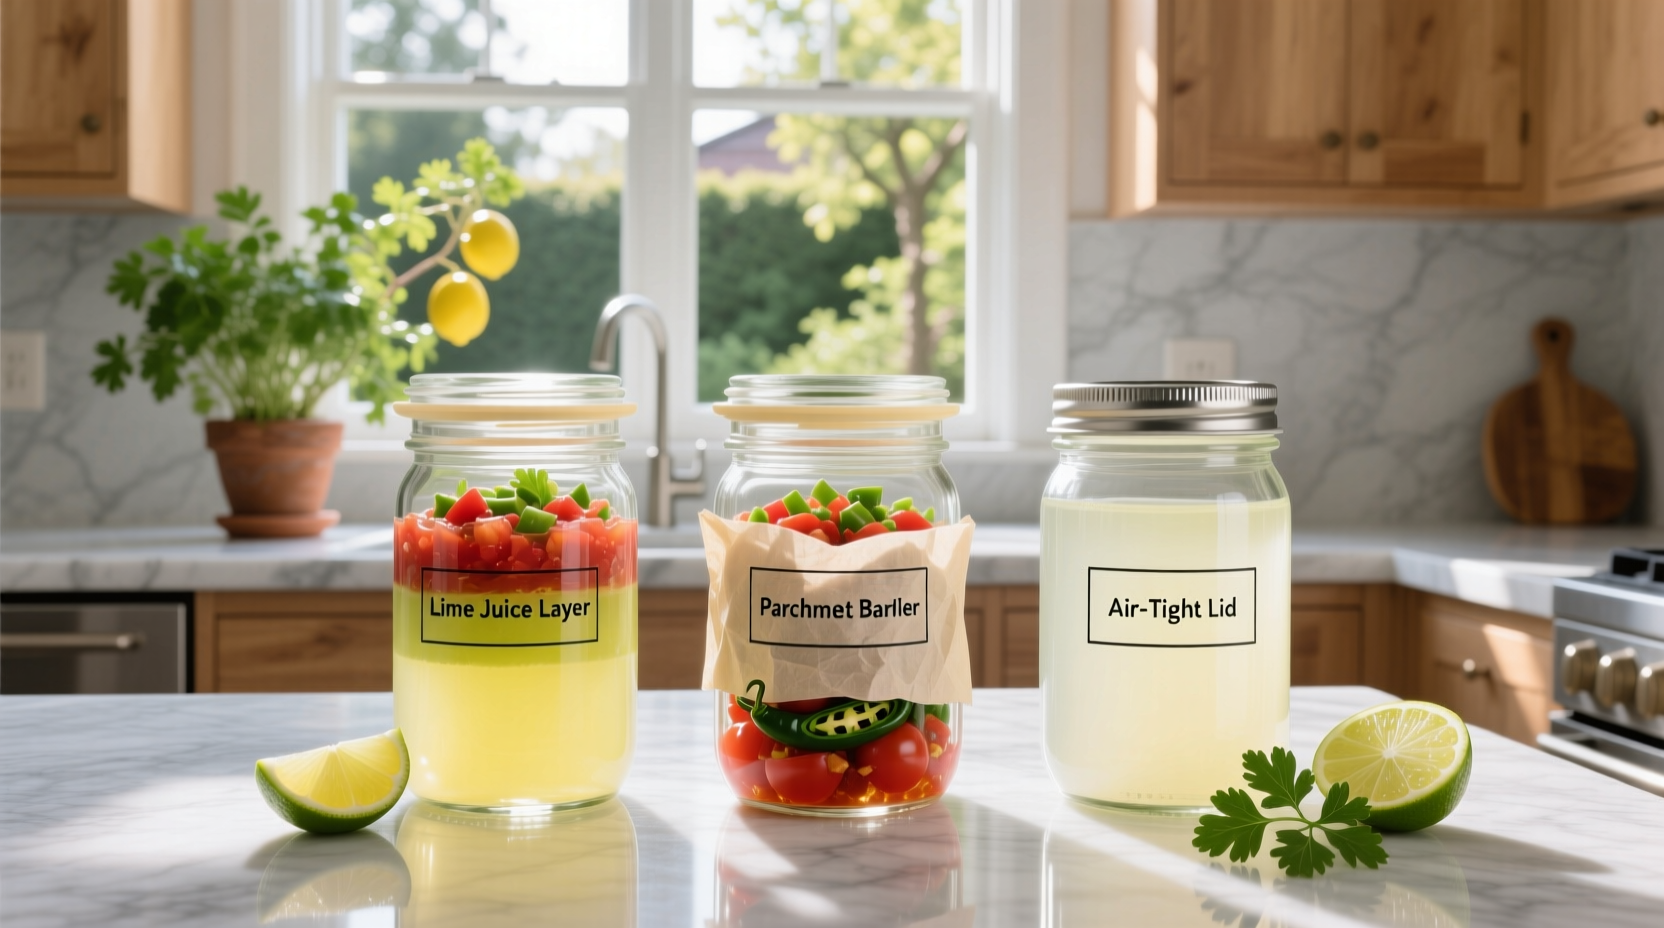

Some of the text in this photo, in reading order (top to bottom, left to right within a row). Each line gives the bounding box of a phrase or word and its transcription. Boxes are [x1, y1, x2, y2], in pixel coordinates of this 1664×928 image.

[430, 597, 591, 622] Lime Juice Layer
[760, 597, 854, 619] Parchmet
[1108, 596, 1237, 625] Air-Tight Lid
